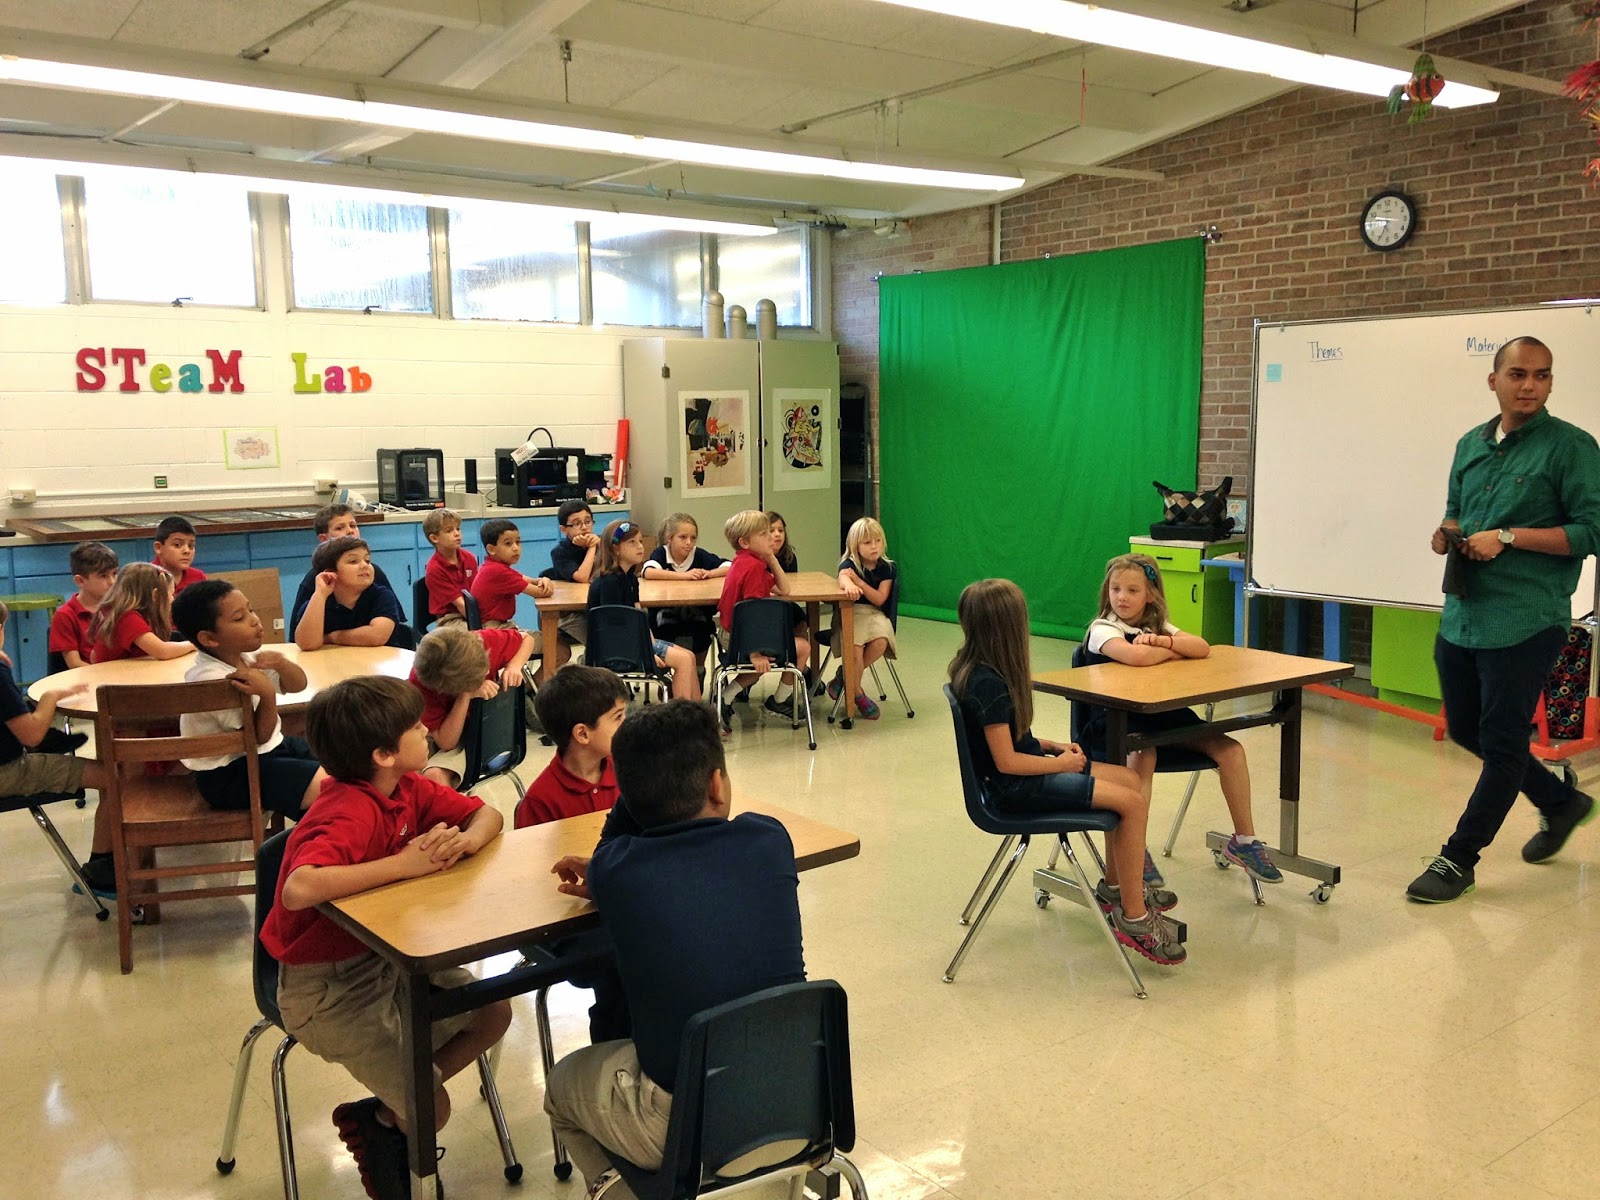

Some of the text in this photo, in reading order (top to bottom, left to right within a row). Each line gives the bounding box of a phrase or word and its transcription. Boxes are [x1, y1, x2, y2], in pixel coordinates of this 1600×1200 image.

[1306, 341, 1343, 359] Themes
[76, 347, 372, 393] STeaM Lab
